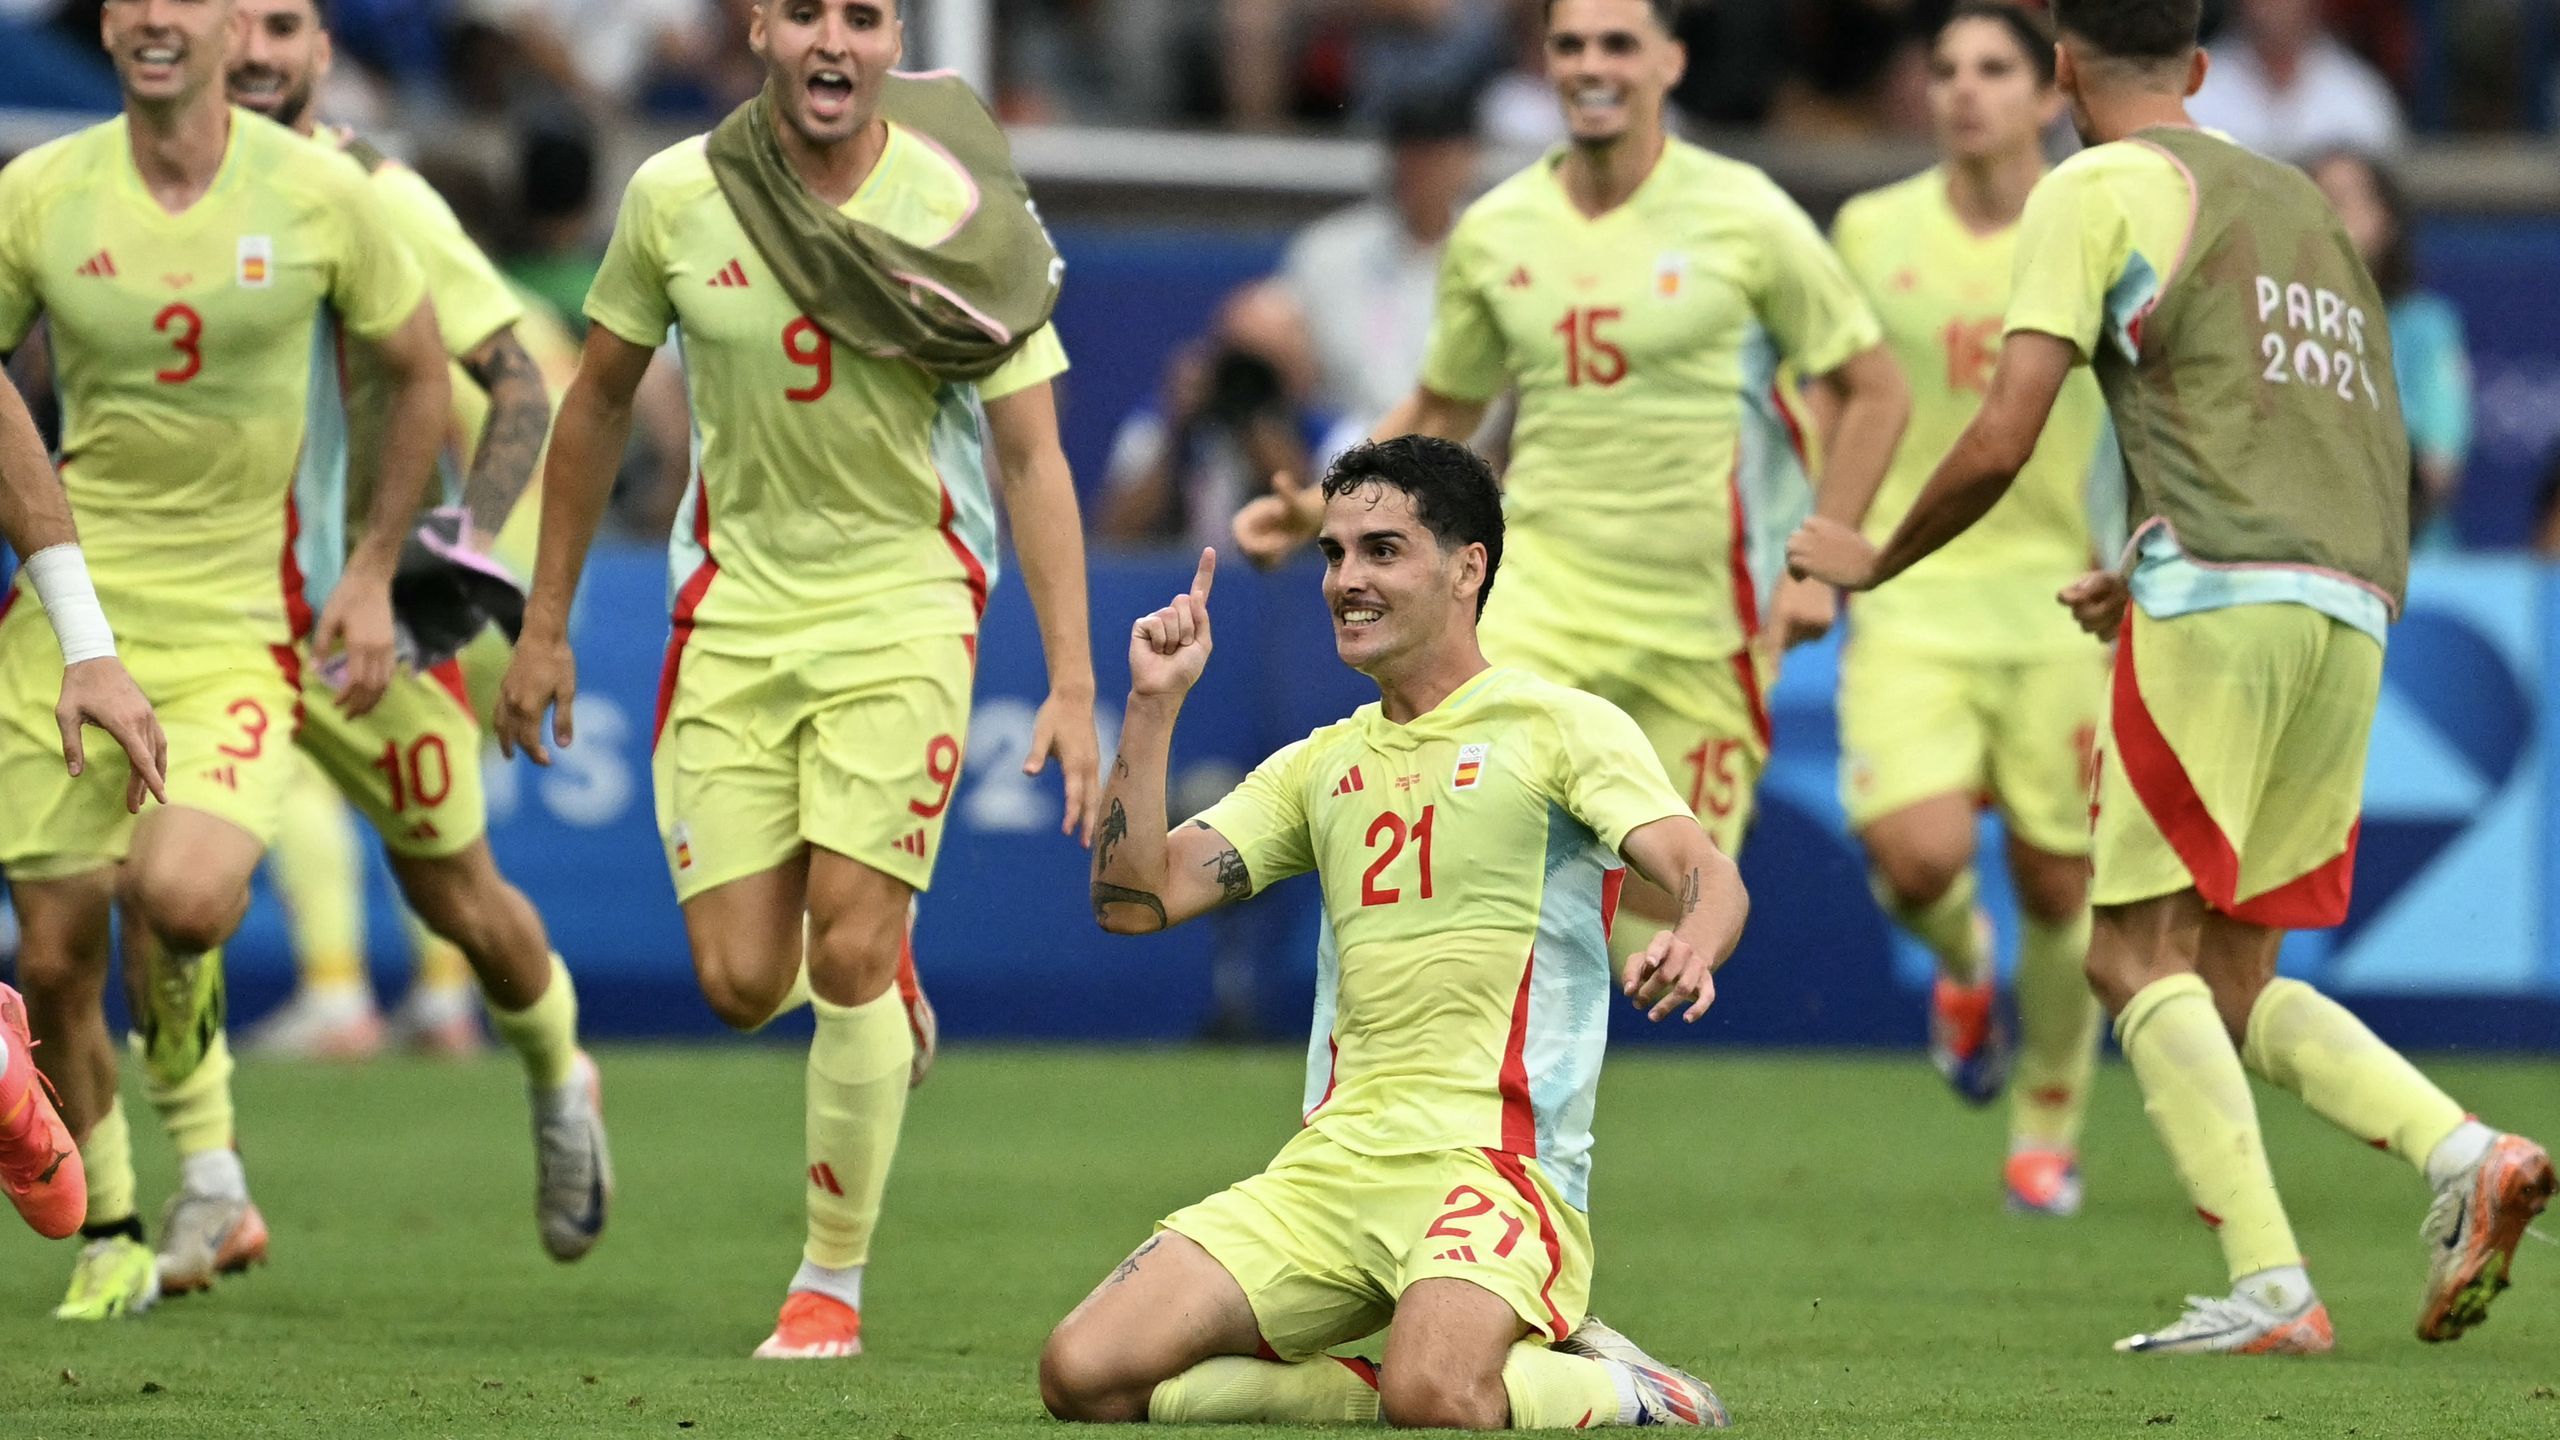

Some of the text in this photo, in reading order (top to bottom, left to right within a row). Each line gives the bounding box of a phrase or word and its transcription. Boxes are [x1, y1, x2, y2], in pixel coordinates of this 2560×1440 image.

[154, 303, 203, 384] 3
[1554, 305, 1629, 388] 15
[2256, 275, 2366, 354] PARS
[781, 315, 833, 403] 9
[217, 697, 269, 760] 3
[374, 732, 454, 813] 10
[907, 734, 959, 819] 9
[1684, 737, 1745, 818] 15
[1361, 804, 1435, 907] 21
[1424, 1184, 1525, 1259] 21
